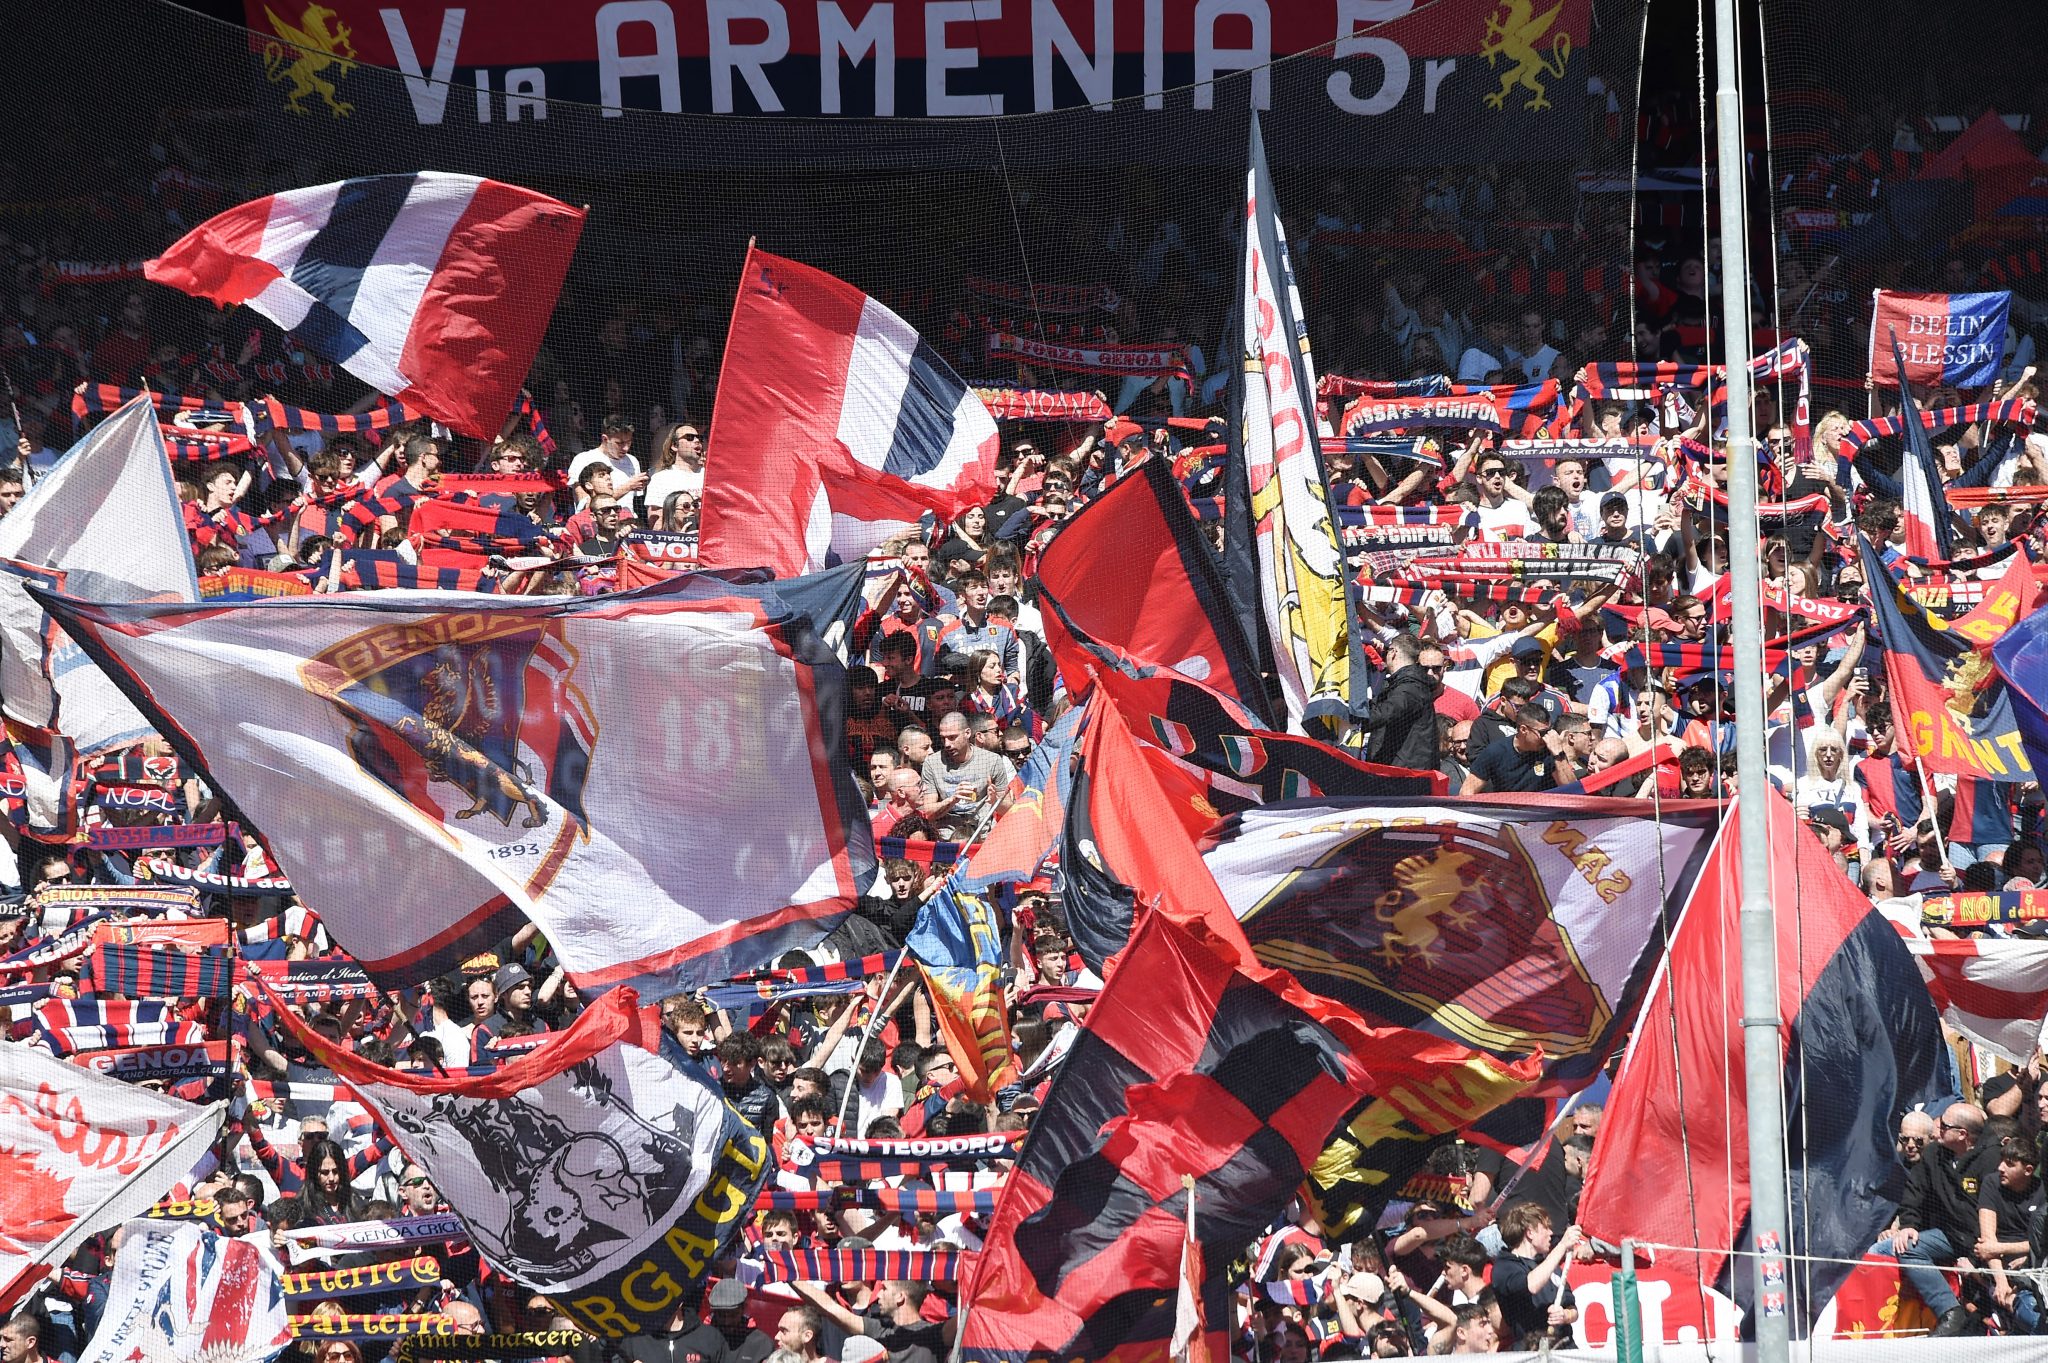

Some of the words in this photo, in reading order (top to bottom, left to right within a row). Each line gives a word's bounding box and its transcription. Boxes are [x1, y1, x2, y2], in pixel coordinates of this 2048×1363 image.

[595, 0, 1272, 118] ARMENIA
[1908, 315, 1986, 336] BELIN
[1024, 340, 1084, 363] FORZA
[1098, 352, 1163, 367] GENOA
[1891, 342, 1994, 365] BLESSIN
[992, 389, 1105, 420] GENOANO
[1790, 596, 1856, 620] FORZ
[335, 613, 525, 676] GENOA
[487, 843, 540, 860] 1893
[39, 888, 93, 904] GENOA
[1960, 895, 2001, 922] NOI
[2008, 906, 2046, 919] della
[280, 971, 318, 982] antico
[321, 966, 369, 982] d'Itali
[258, 991, 300, 1001] CCKET
[304, 990, 327, 998] AND
[330, 987, 379, 997] FOOTBAL
[89, 1048, 212, 1074] GENOA
[123, 1071, 145, 1079] AND
[147, 1067, 197, 1077] FOOTBALL
[200, 1066, 226, 1075] CLUB
[814, 1136, 870, 1156] SAN
[876, 1134, 1007, 1157] TEODORO
[353, 1226, 414, 1243] GENOA
[417, 1220, 466, 1237] CRICK
[280, 1261, 403, 1295] arterre
[490, 1330, 583, 1348] nascere
